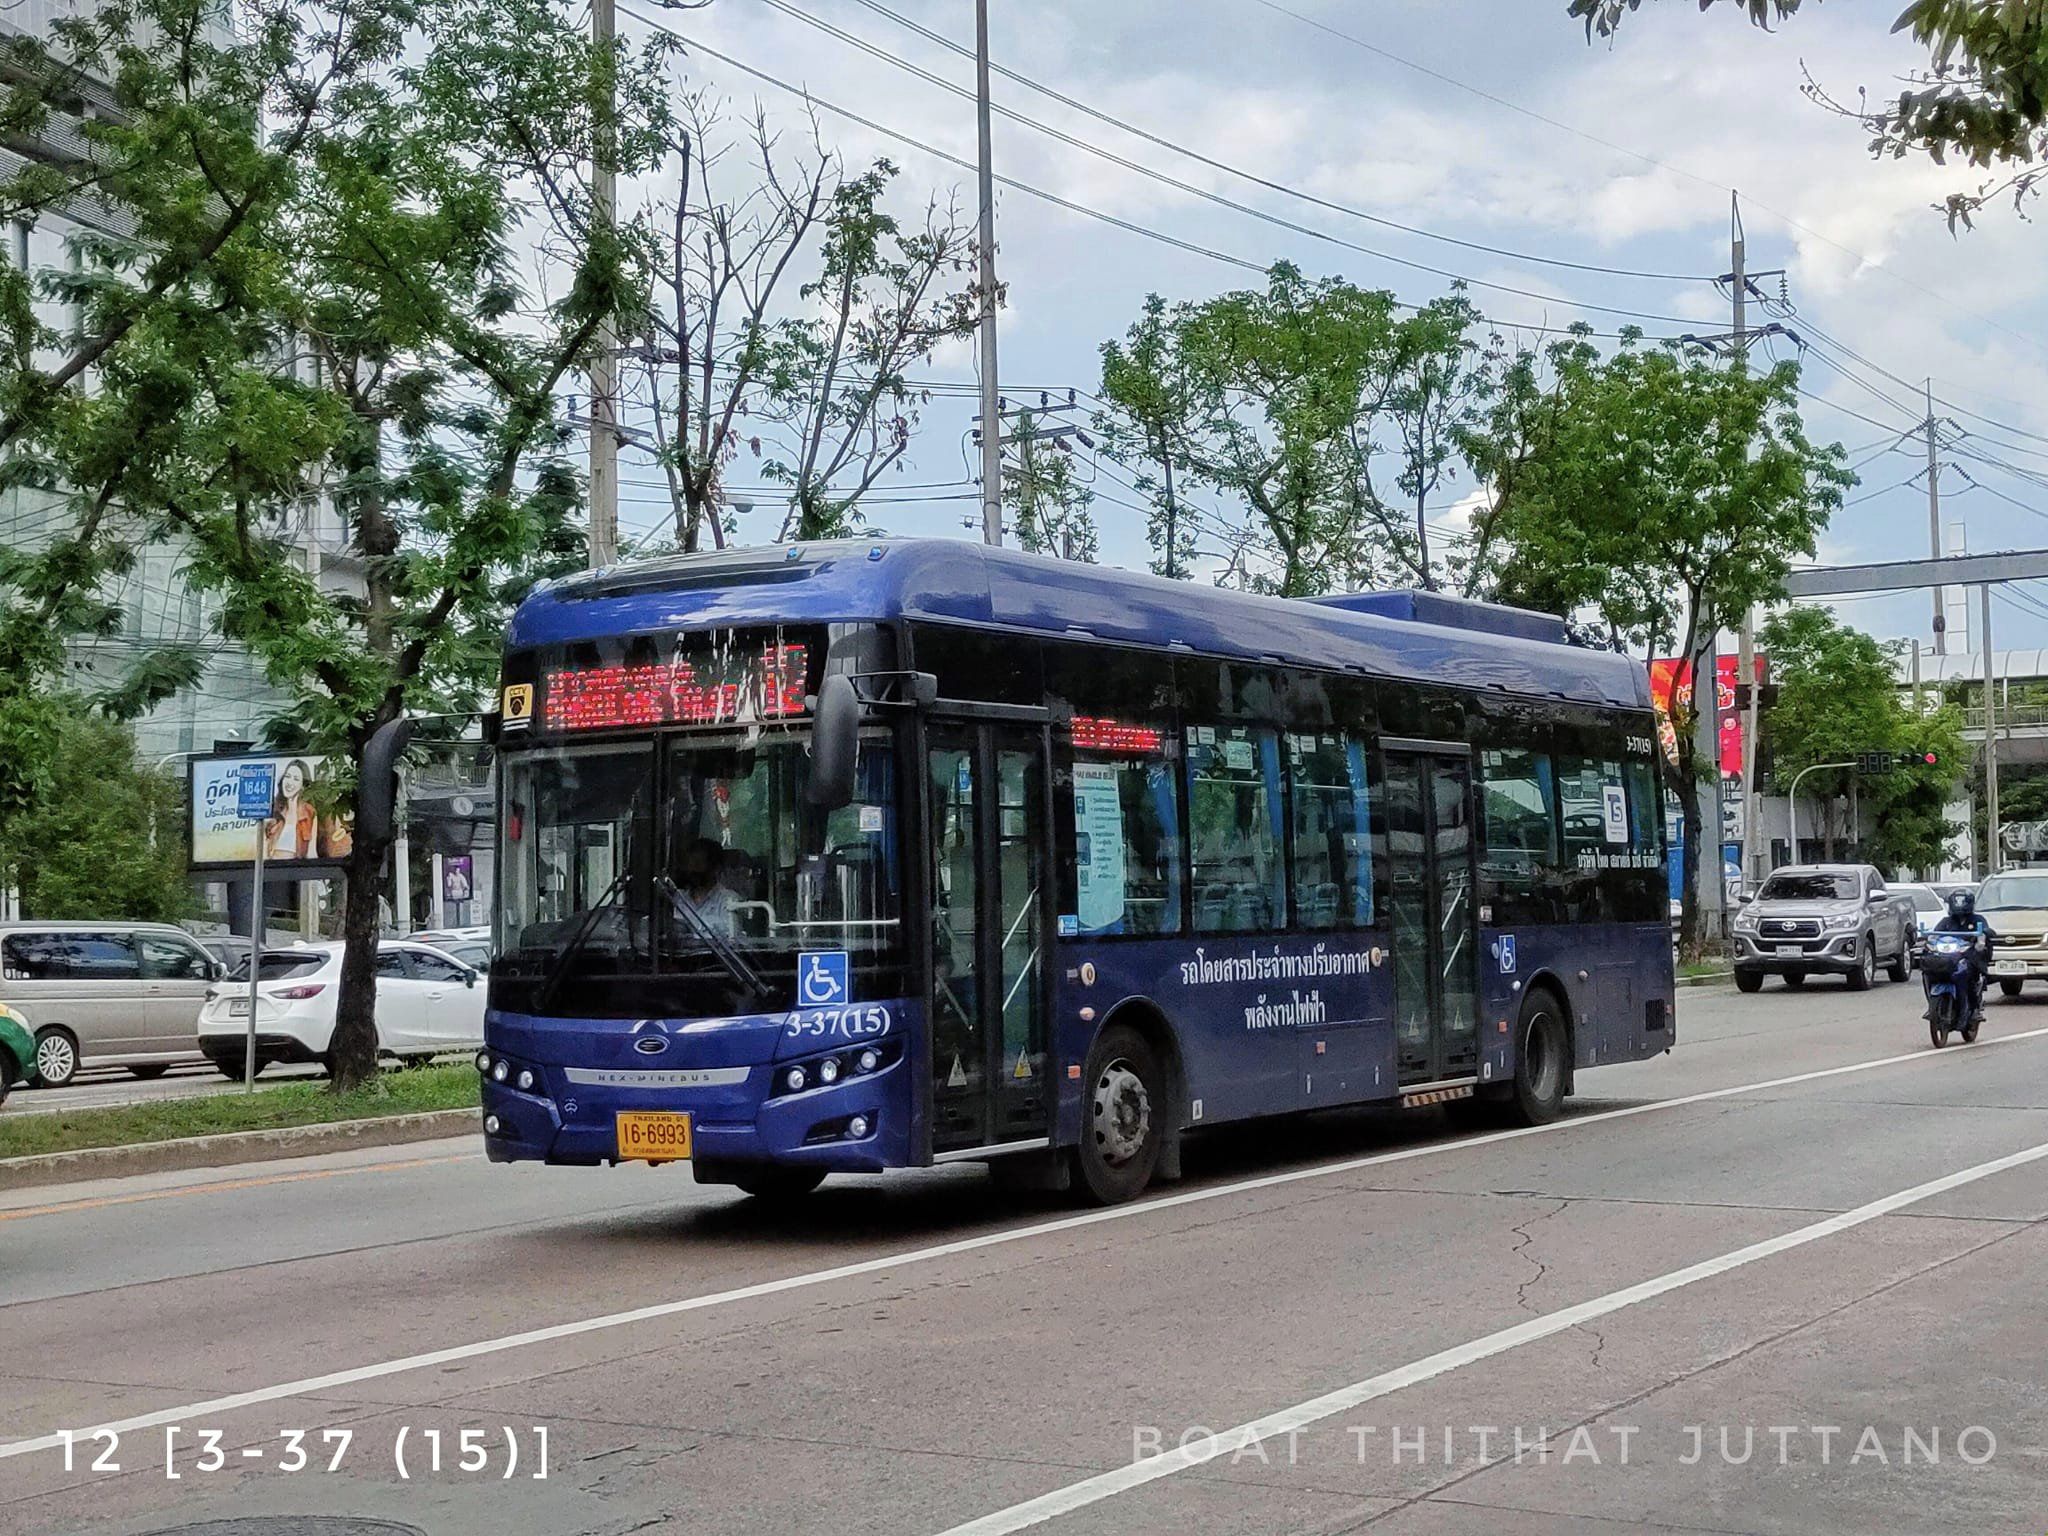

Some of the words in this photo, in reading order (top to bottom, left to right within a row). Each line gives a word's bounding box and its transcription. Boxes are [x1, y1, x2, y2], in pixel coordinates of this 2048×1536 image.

[1180, 943, 1370, 985] รถโดยสารประจำทางปรับอากาศ
[787, 1006, 891, 1038] 3-37(15)
[1244, 990, 1326, 1029] พลังงานไฟฟ้า
[623, 1123, 686, 1145] 16-6993
